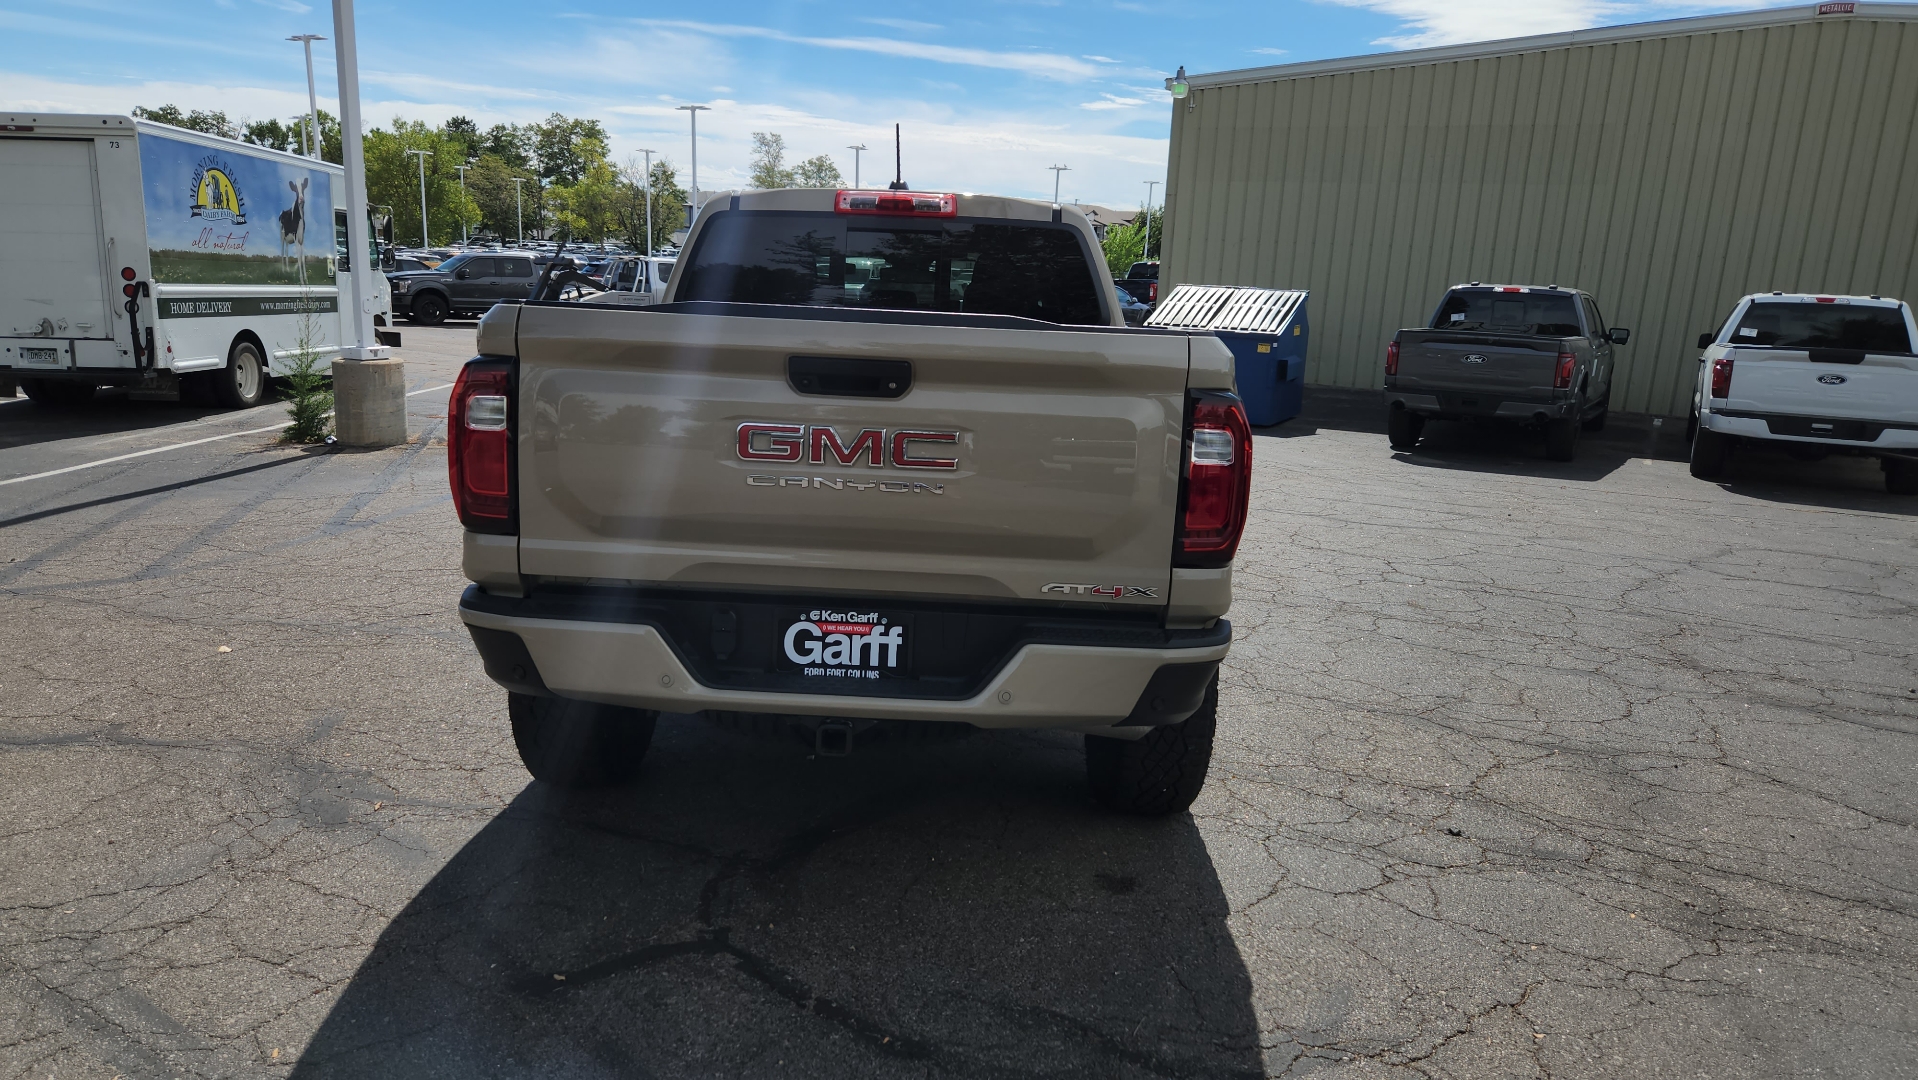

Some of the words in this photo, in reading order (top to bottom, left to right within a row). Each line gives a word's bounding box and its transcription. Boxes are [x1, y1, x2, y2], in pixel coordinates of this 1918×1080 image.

[109, 141, 120, 149] 73
[190, 154, 219, 201] MORNING
[223, 162, 245, 207] FRESH
[192, 227, 213, 249] all
[213, 231, 249, 251] natural
[170, 302, 195, 314] HOME
[196, 301, 232, 313] DELIVERY
[1821, 375, 1842, 384] Ford
[736, 421, 959, 470] GMC
[747, 474, 944, 495] CANYON
[1041, 582, 1158, 600] AT4X
[821, 610, 846, 622] Ken
[847, 611, 878, 623] Garff
[783, 621, 903, 668] Garff
[804, 667, 824, 677] FORD
[827, 669, 846, 678] FORT
[848, 670, 880, 680] COLLINS
